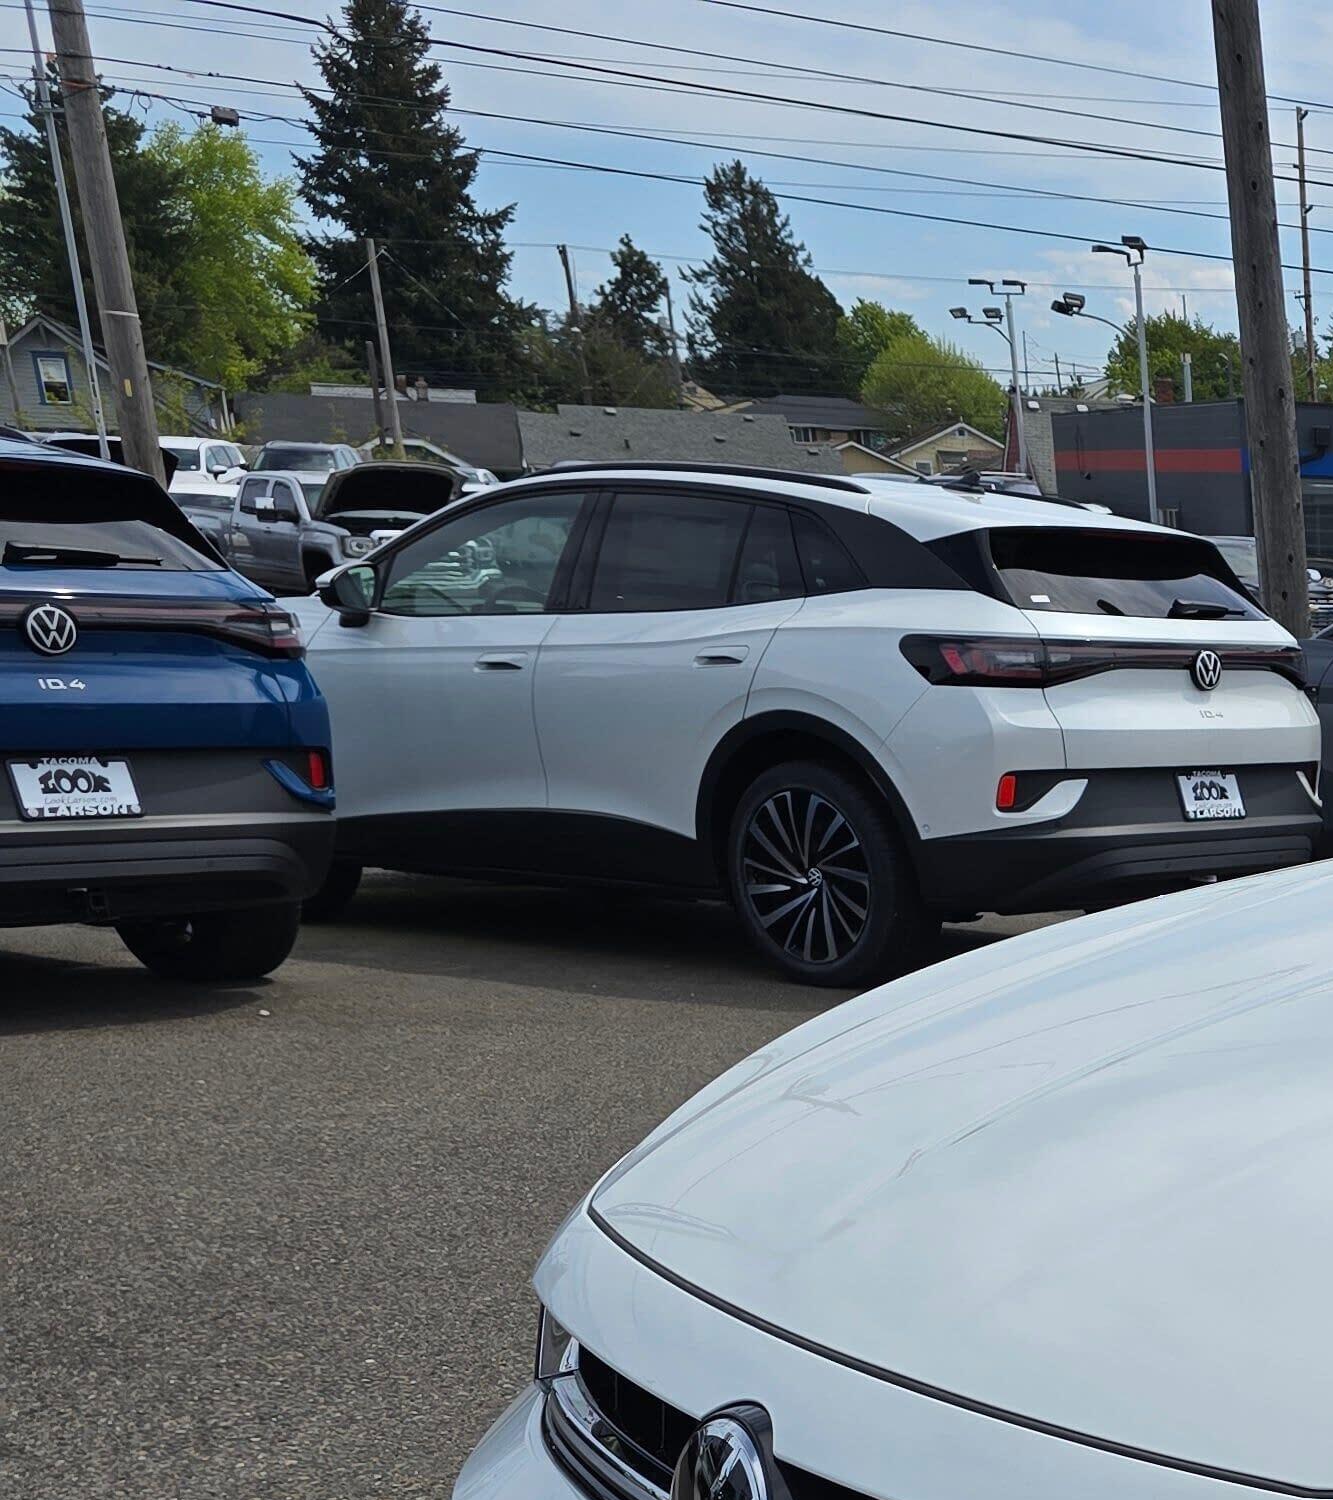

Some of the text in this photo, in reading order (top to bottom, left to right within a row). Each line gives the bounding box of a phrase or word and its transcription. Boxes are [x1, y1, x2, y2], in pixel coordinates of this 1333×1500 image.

[41, 756, 99, 765] TACOMA
[38, 768, 112, 794] LOOK
[43, 804, 129, 817] LARSON
